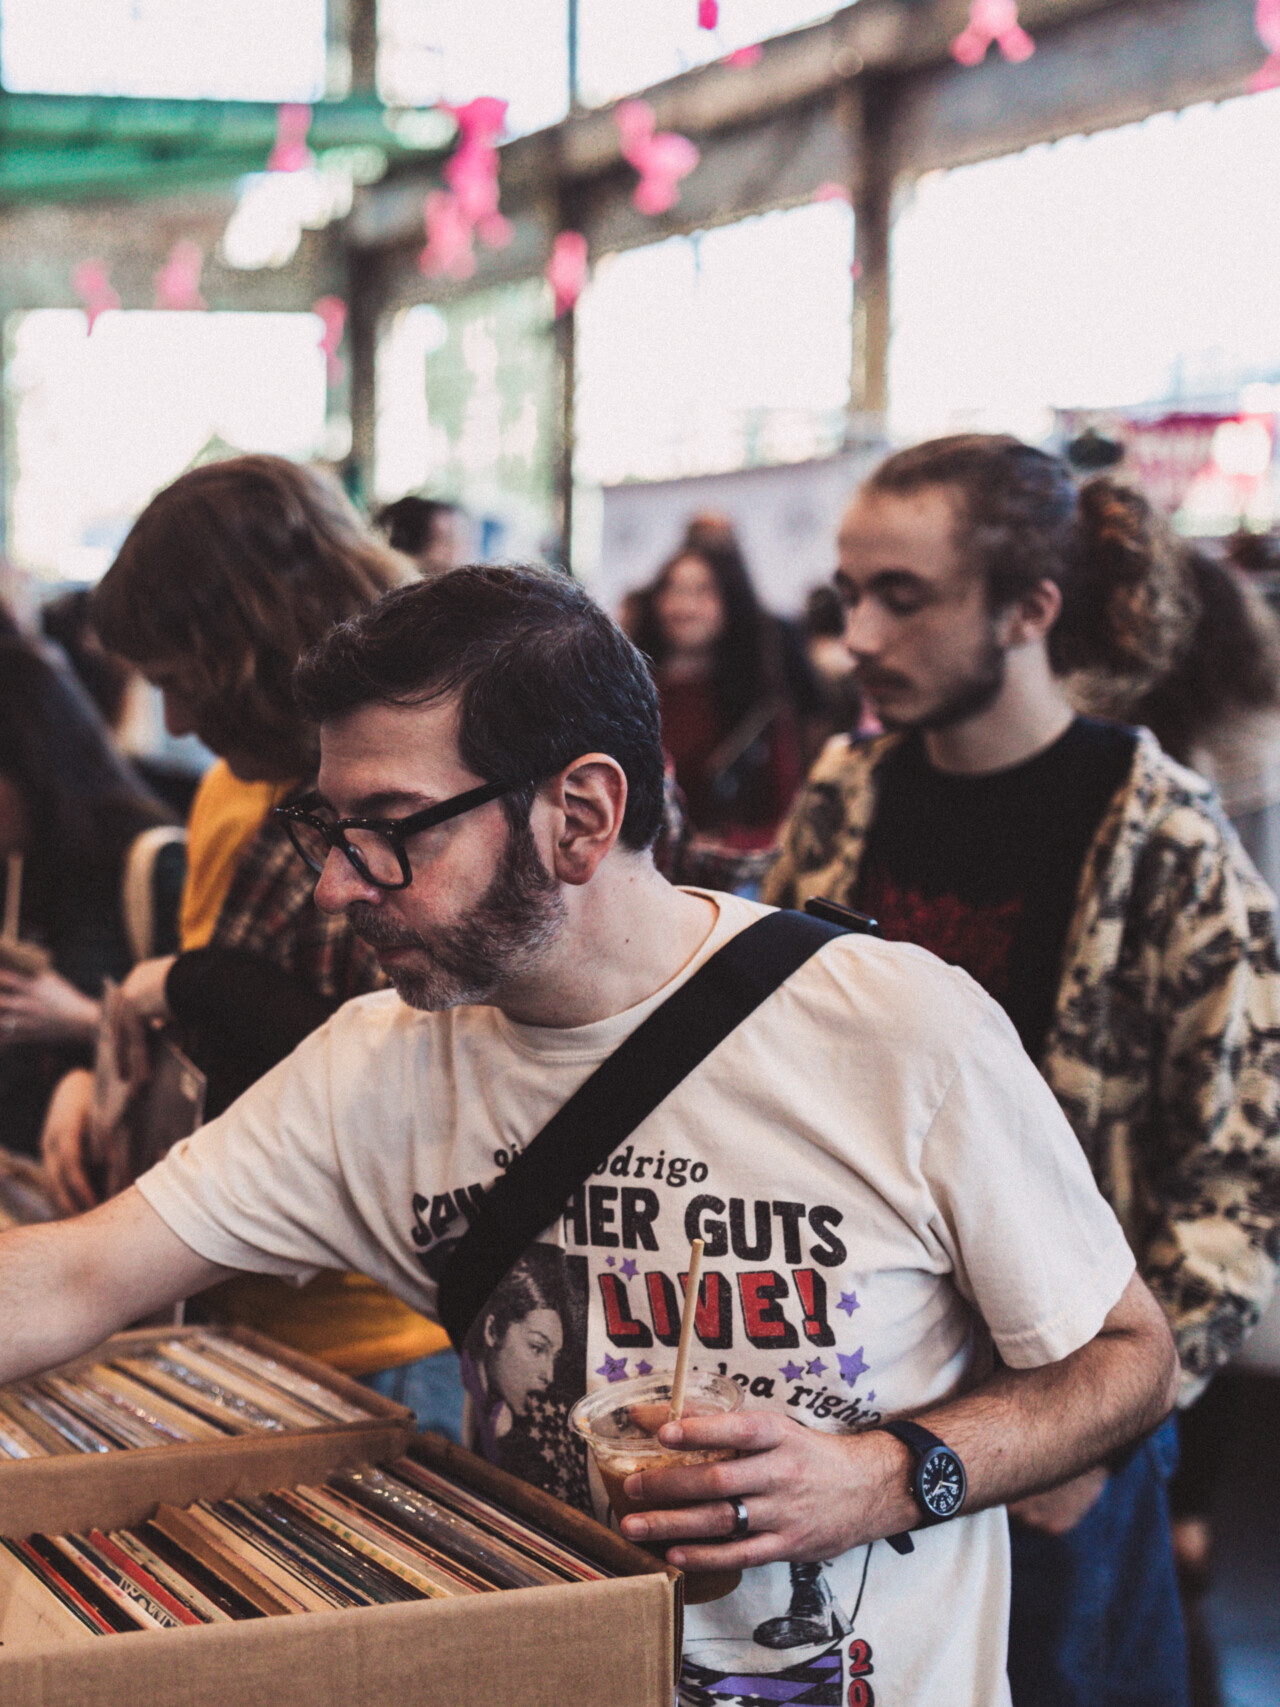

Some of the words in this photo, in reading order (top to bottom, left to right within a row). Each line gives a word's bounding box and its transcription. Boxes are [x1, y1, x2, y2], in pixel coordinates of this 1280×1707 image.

[592, 1144, 709, 1188] odrigo
[684, 1194, 847, 1267] GUTS
[598, 1268, 836, 1350] LIVE!
